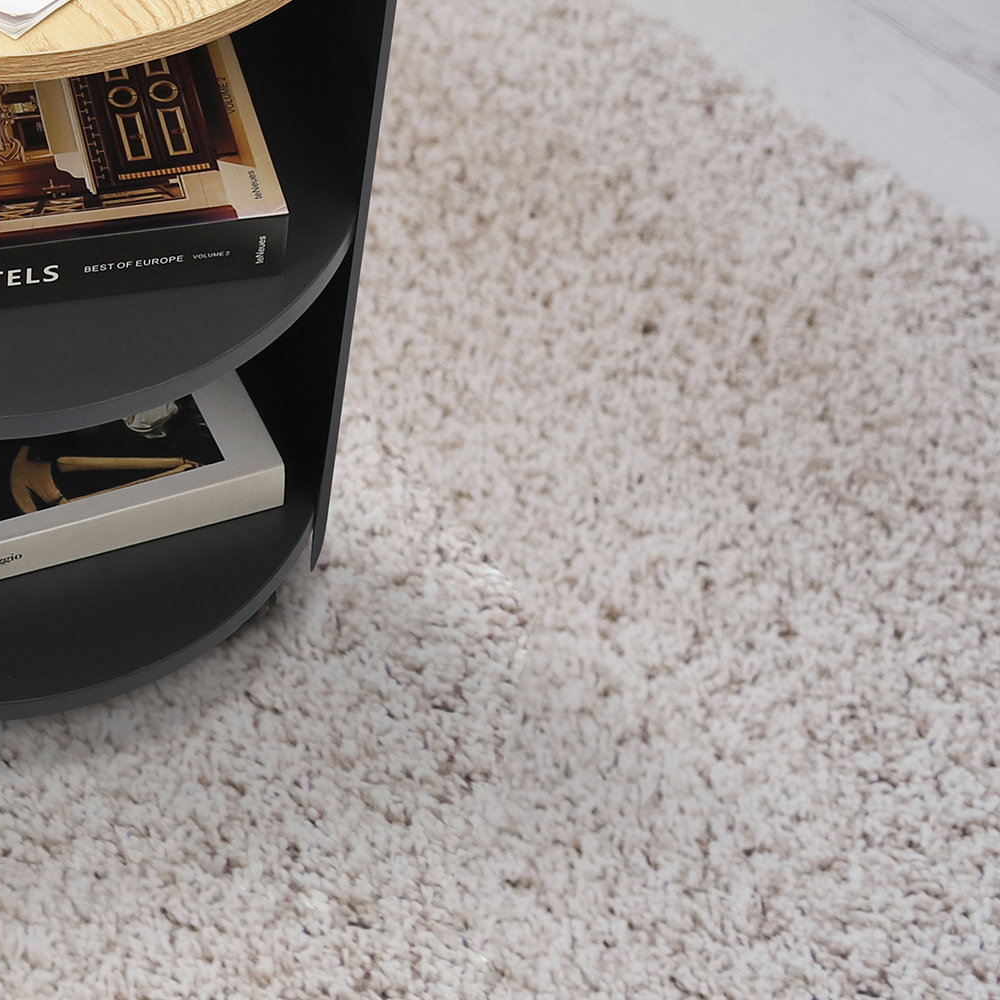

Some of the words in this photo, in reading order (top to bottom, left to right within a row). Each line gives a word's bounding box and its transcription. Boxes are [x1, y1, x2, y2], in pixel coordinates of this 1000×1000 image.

[218, 82, 236, 115] VOLUME
[83, 262, 115, 273] BEST
[116, 260, 133, 270] OF
[135, 254, 184, 267] EUROPE
[192, 251, 224, 260] VOLUME
